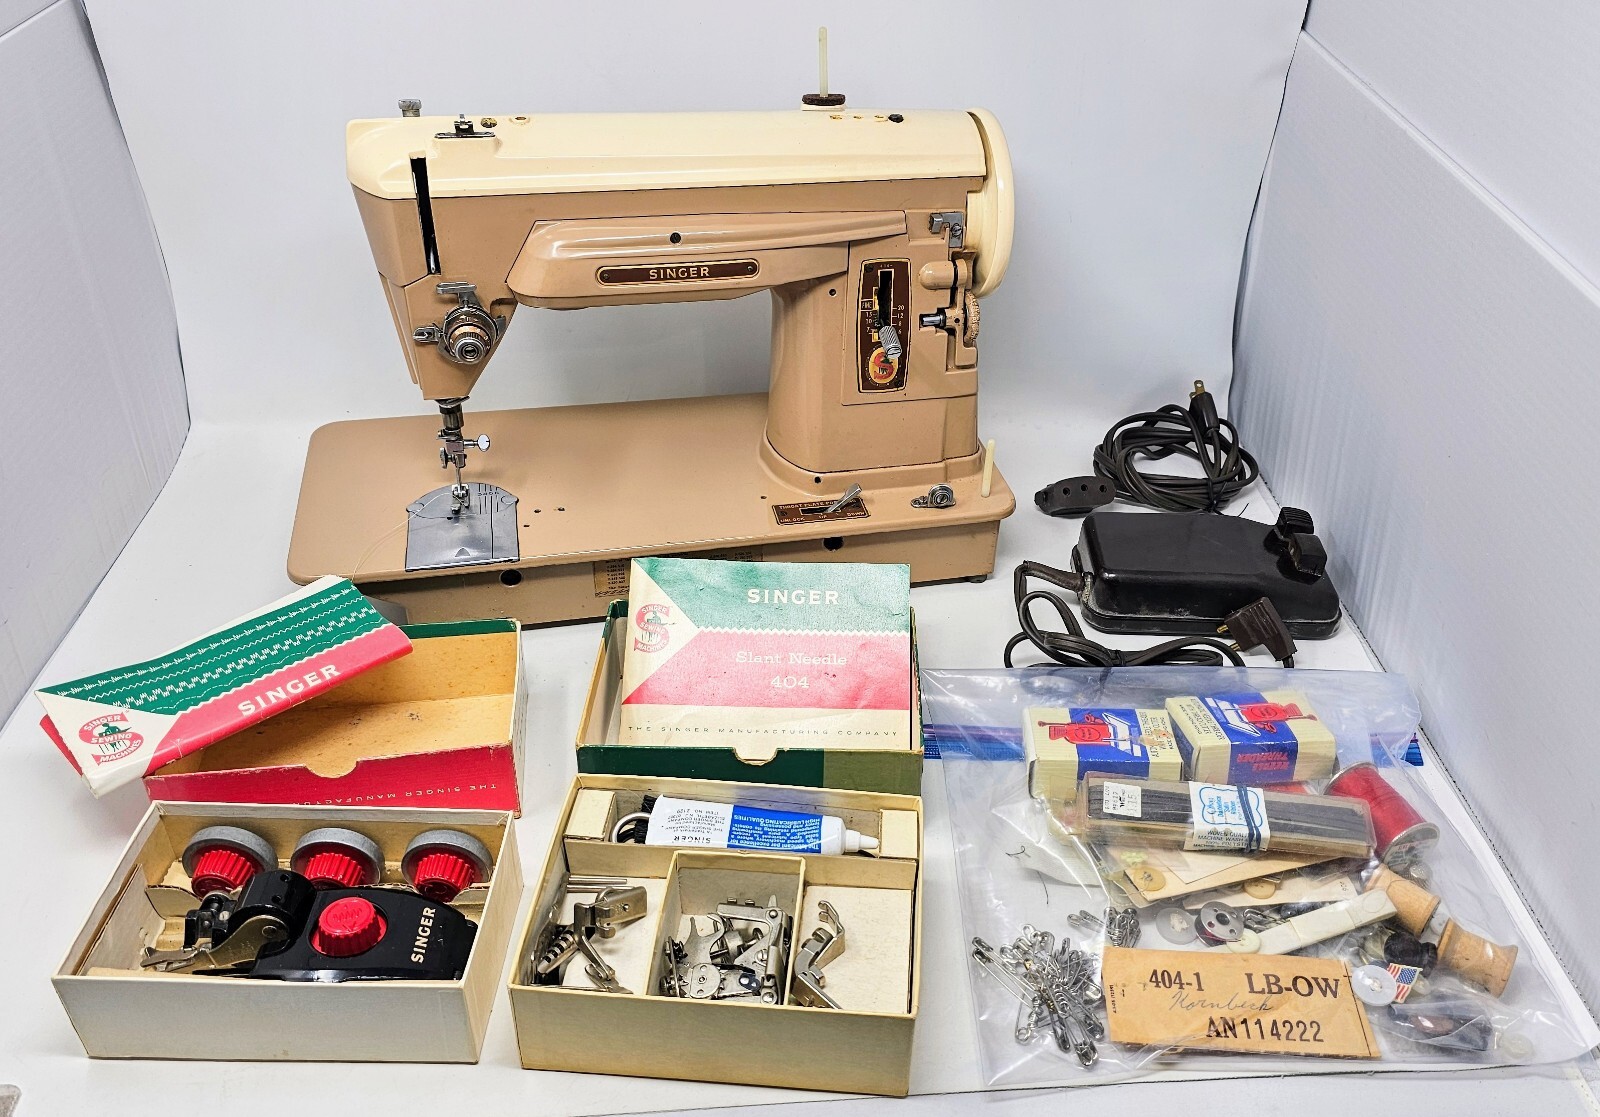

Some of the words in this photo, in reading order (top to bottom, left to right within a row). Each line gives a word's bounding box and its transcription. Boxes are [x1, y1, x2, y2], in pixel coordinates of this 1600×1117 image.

[649, 266, 710, 280] SINGER
[746, 588, 839, 605] SINGER
[641, 605, 667, 614] SINGER
[735, 651, 781, 664] Slant
[788, 652, 848, 666] Needle
[770, 675, 811, 689] 404
[237, 664, 342, 717] SINGER
[83, 714, 122, 731] SINGER
[91, 733, 132, 744] SEWING
[718, 728, 829, 736] MANUFACTURING
[100, 739, 142, 763] MACHINES
[405, 787, 461, 797] SINGER
[673, 835, 711, 844] SINGER
[410, 906, 437, 964] SINGER
[1149, 969, 1205, 992] 404-1
[1244, 972, 1341, 999] LB-OW
[1205, 1015, 1325, 1043] AN114222
